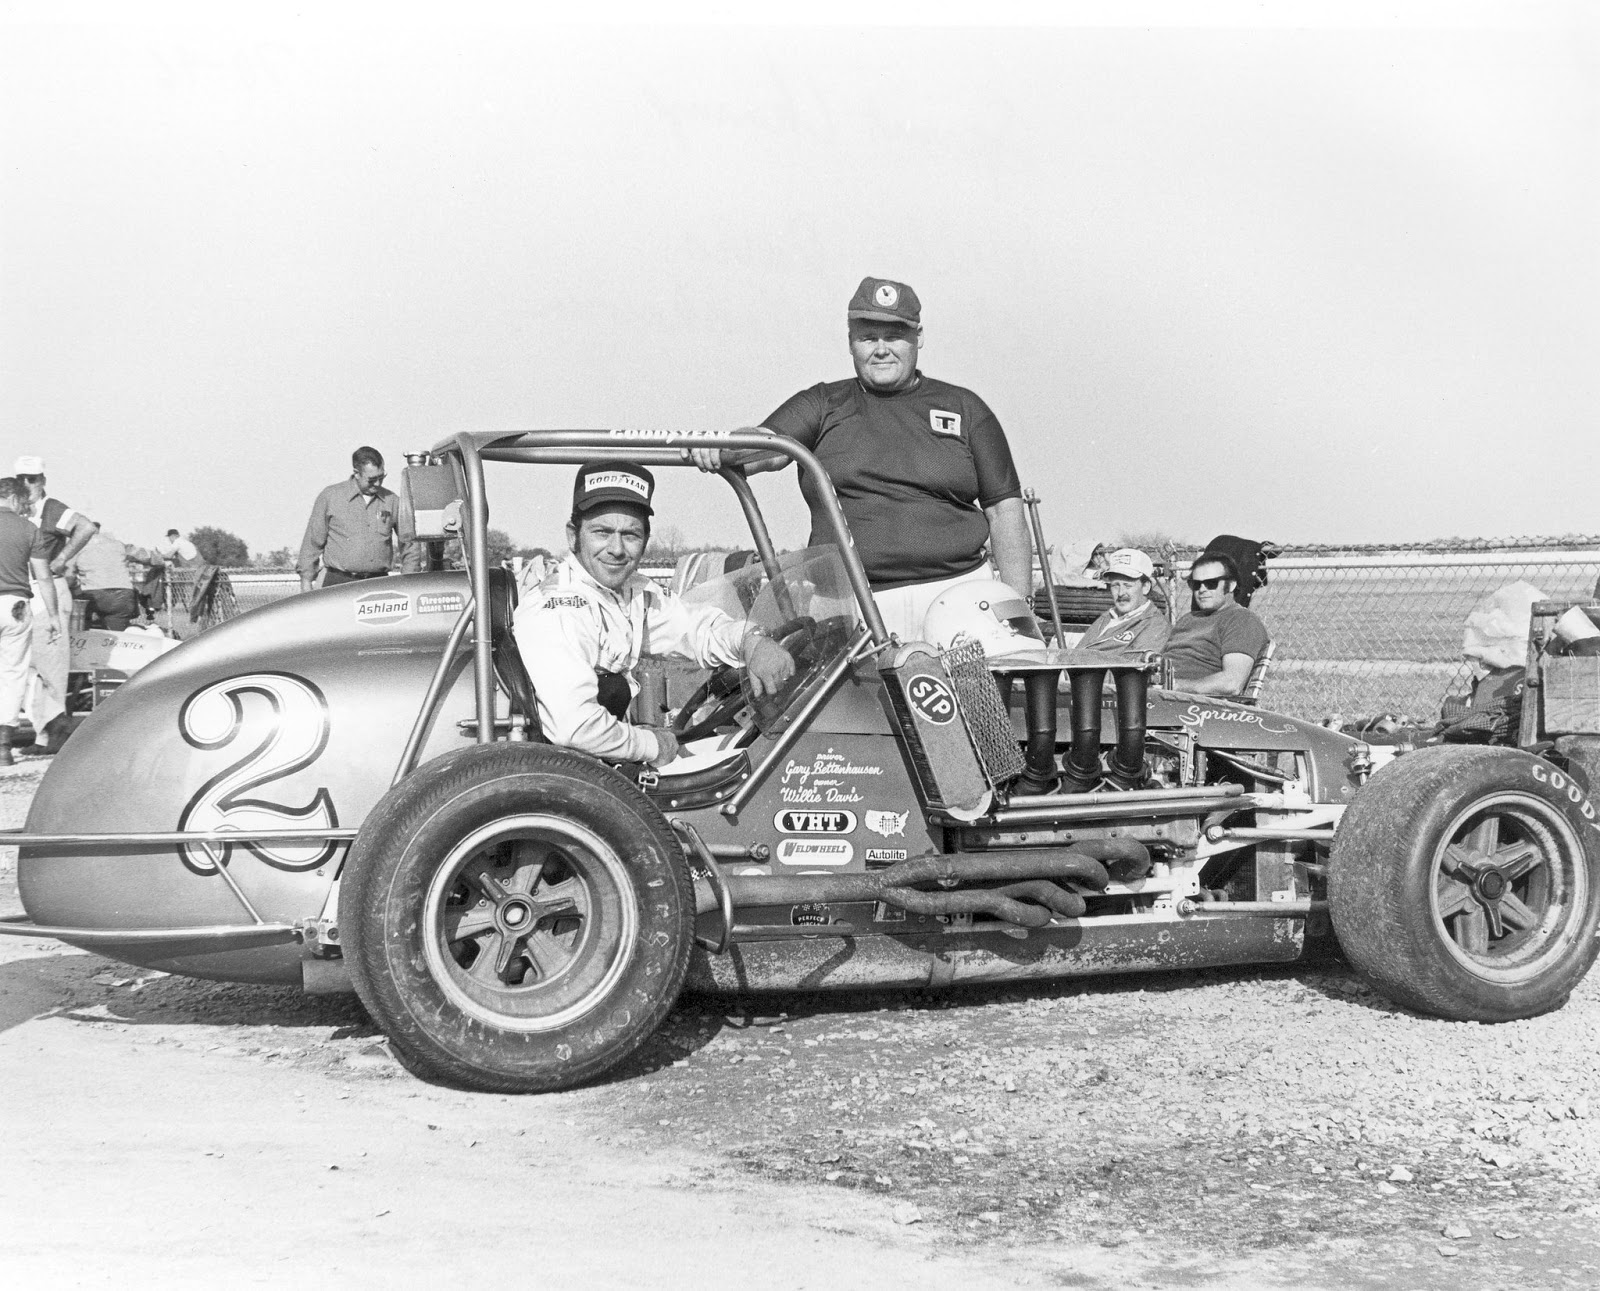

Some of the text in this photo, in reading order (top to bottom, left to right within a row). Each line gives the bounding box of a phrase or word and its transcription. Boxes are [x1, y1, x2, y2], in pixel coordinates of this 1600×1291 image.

[589, 474, 646, 491] GOODYEAR
[358, 601, 409, 615] Ashland
[420, 596, 461, 605] Firestone
[913, 681, 951, 714] STP
[1179, 705, 1275, 729] Sprinter
[178, 671, 340, 877] 2
[782, 760, 884, 785] Gary Bettenhausen
[780, 786, 864, 803] Willie Davis
[789, 813, 840, 831] VHT
[868, 849, 905, 860] Autolite
